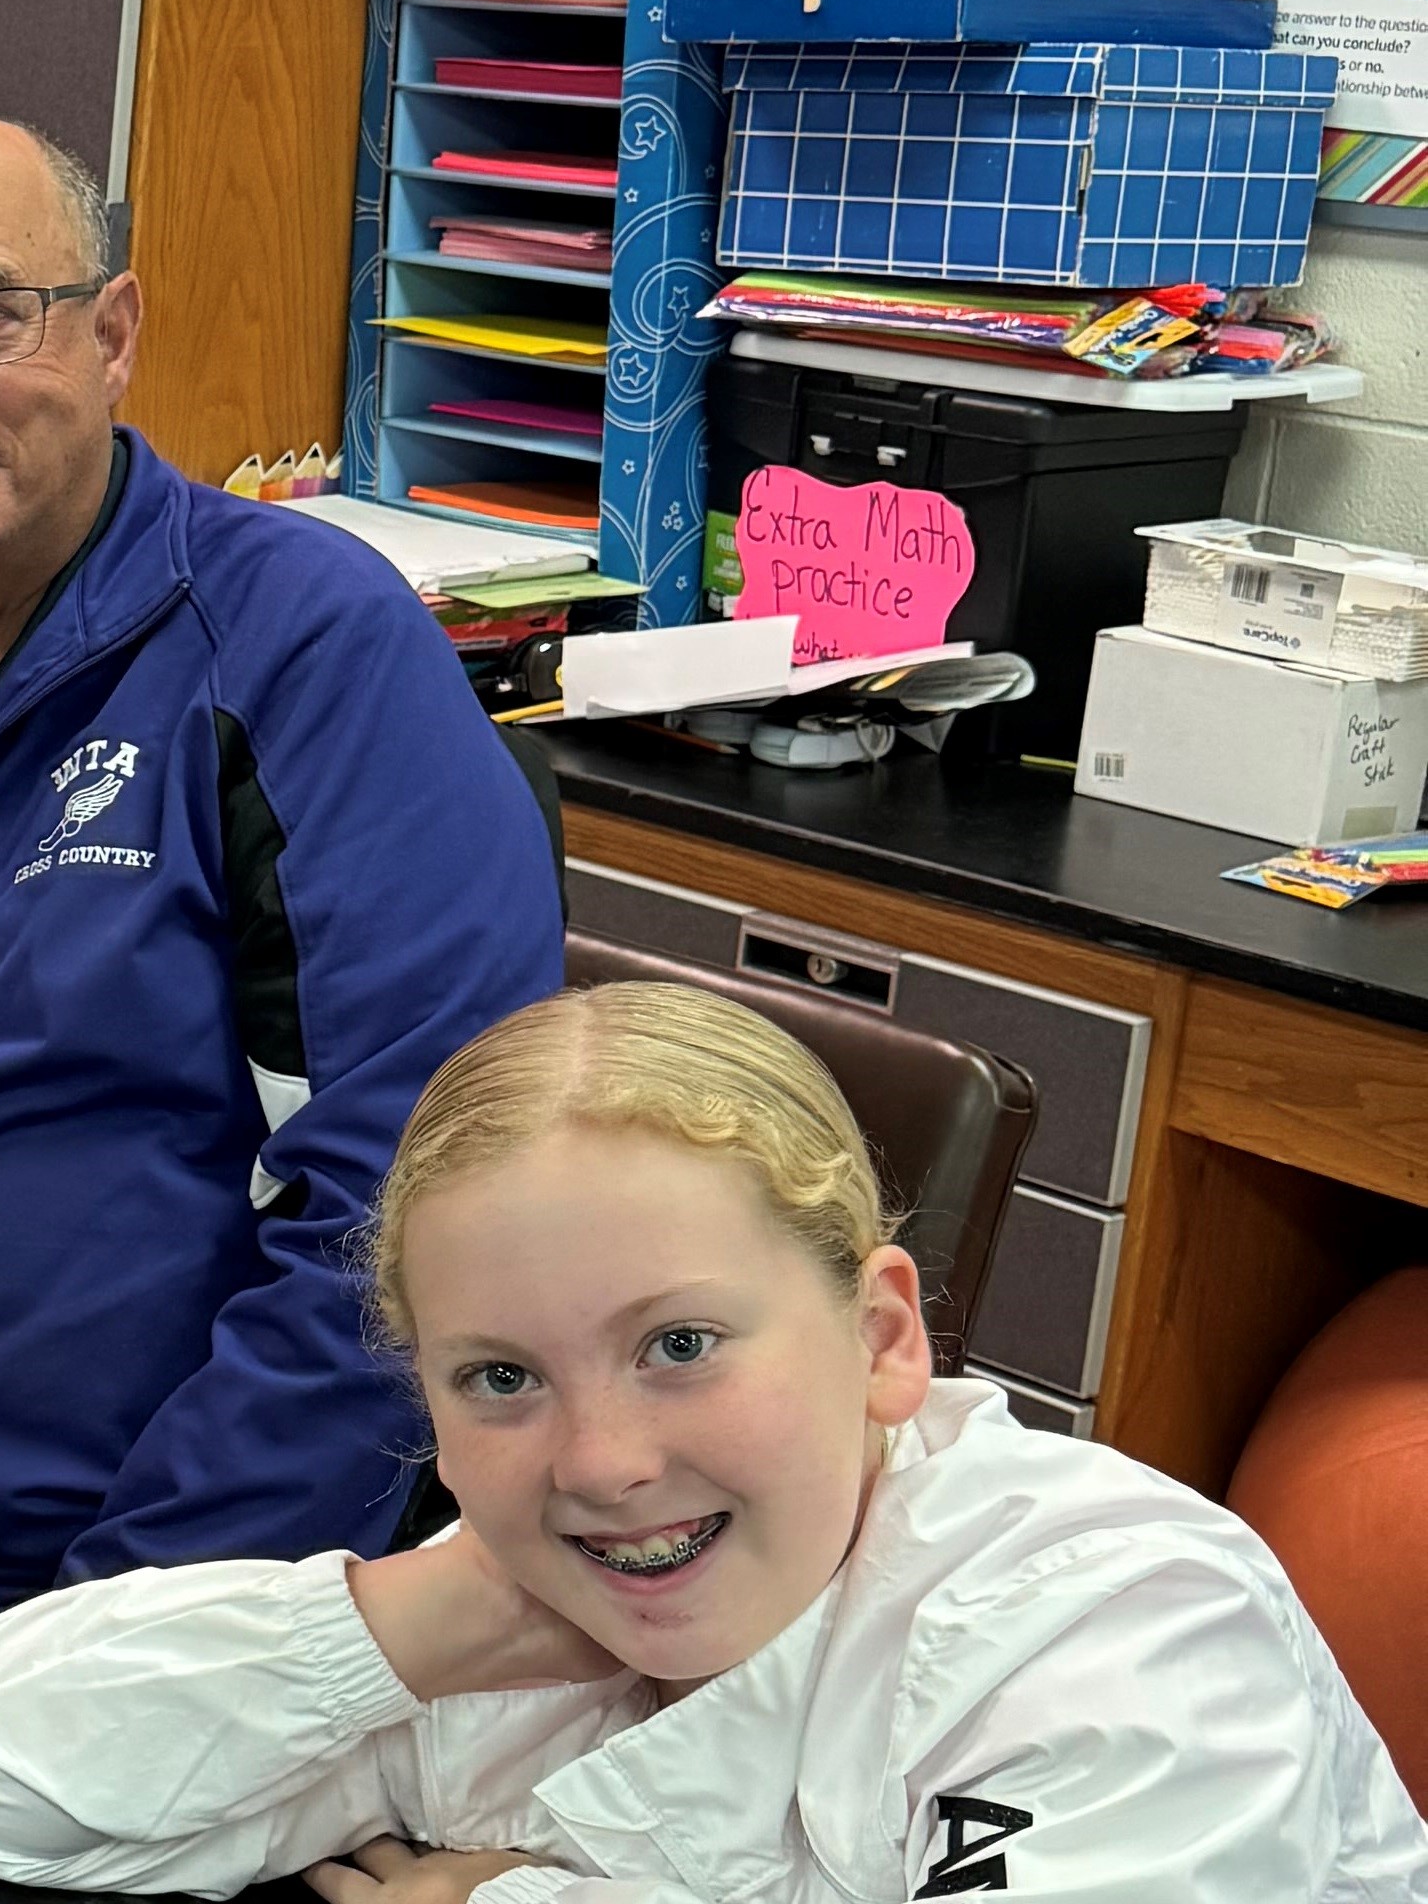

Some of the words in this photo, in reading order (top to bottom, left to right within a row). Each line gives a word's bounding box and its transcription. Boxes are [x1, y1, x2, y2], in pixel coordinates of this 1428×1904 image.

[1293, 12, 1337, 27] answer
[1340, 14, 1352, 28] to
[1355, 15, 1376, 30] the
[1292, 34, 1315, 46] can
[1316, 36, 1340, 50] you
[1343, 38, 1411, 54] conclude?
[1349, 60, 1362, 72] or
[1365, 62, 1384, 74] no.
[746, 467, 838, 550] Extra
[865, 490, 961, 573] Math
[1347, 713, 1400, 744] Regular
[1351, 736, 1386, 764] Craft
[51, 740, 140, 793] WTA
[1364, 756, 1395, 787] Stick
[14, 855, 53, 885] CROSS
[58, 846, 156, 869] COUNTRY
